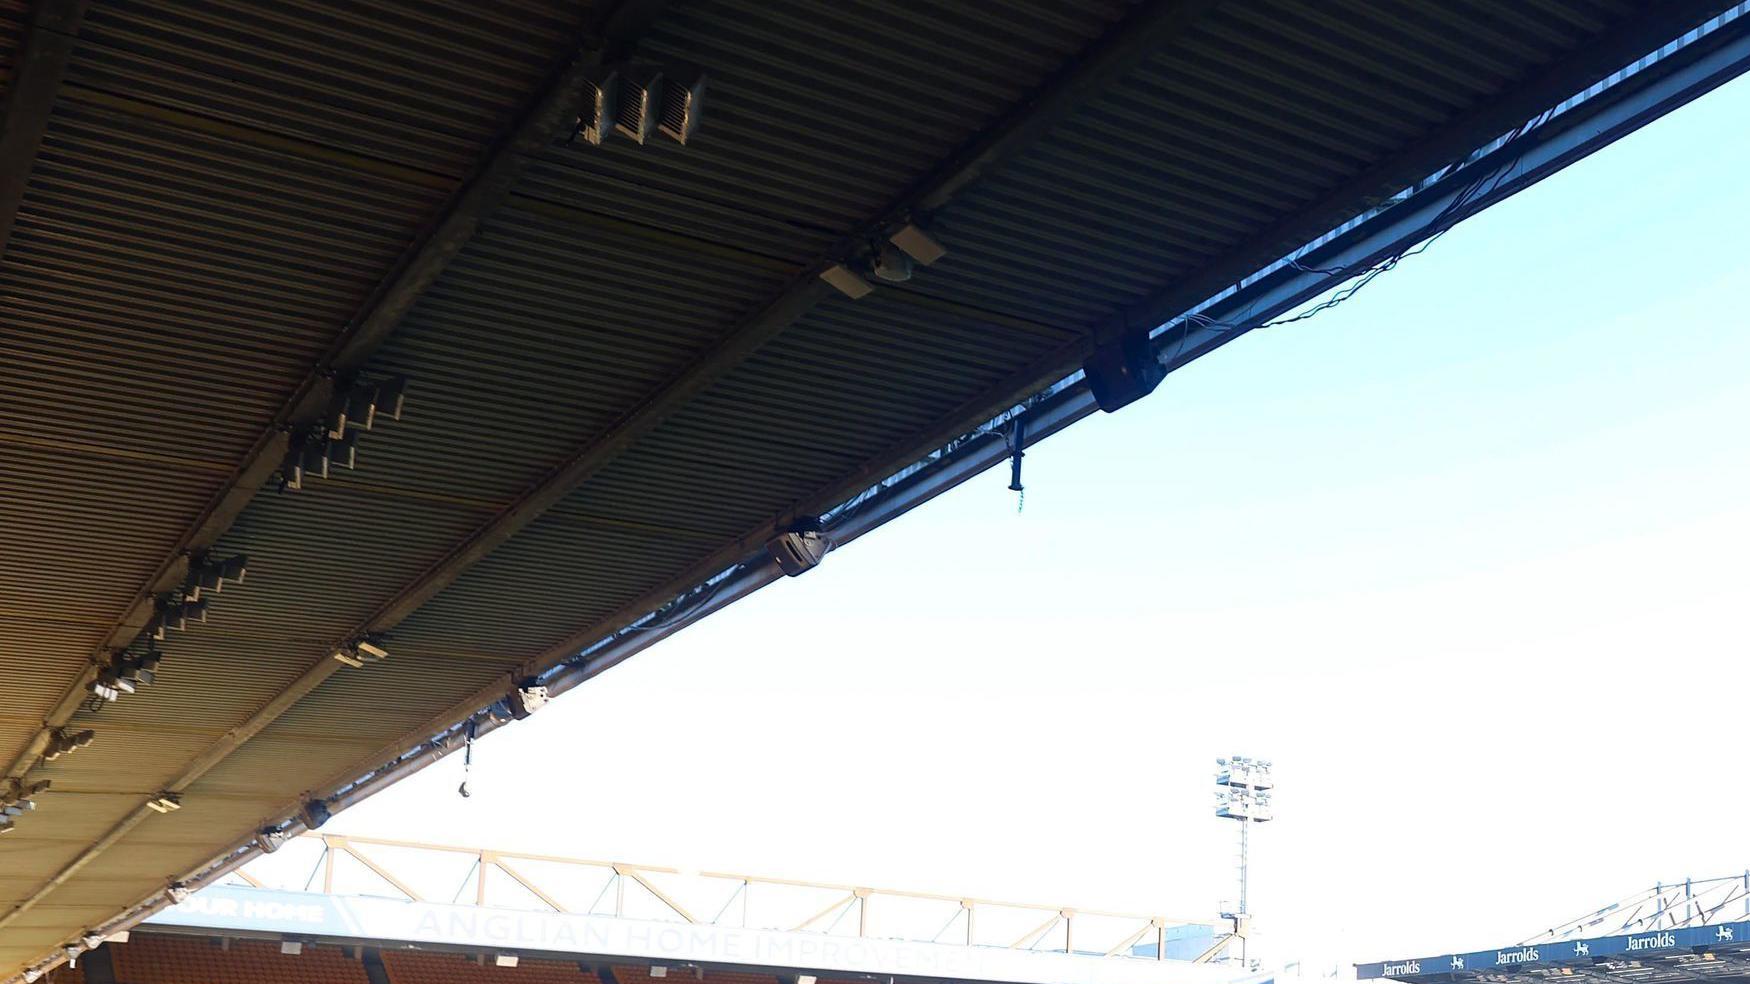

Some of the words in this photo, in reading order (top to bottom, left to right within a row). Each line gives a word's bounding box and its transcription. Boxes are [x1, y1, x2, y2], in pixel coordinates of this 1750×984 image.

[1625, 933, 1675, 951] Jarrolds
[1496, 947, 1538, 966] Jarrolds
[1382, 960, 1420, 977] Jarrolds
